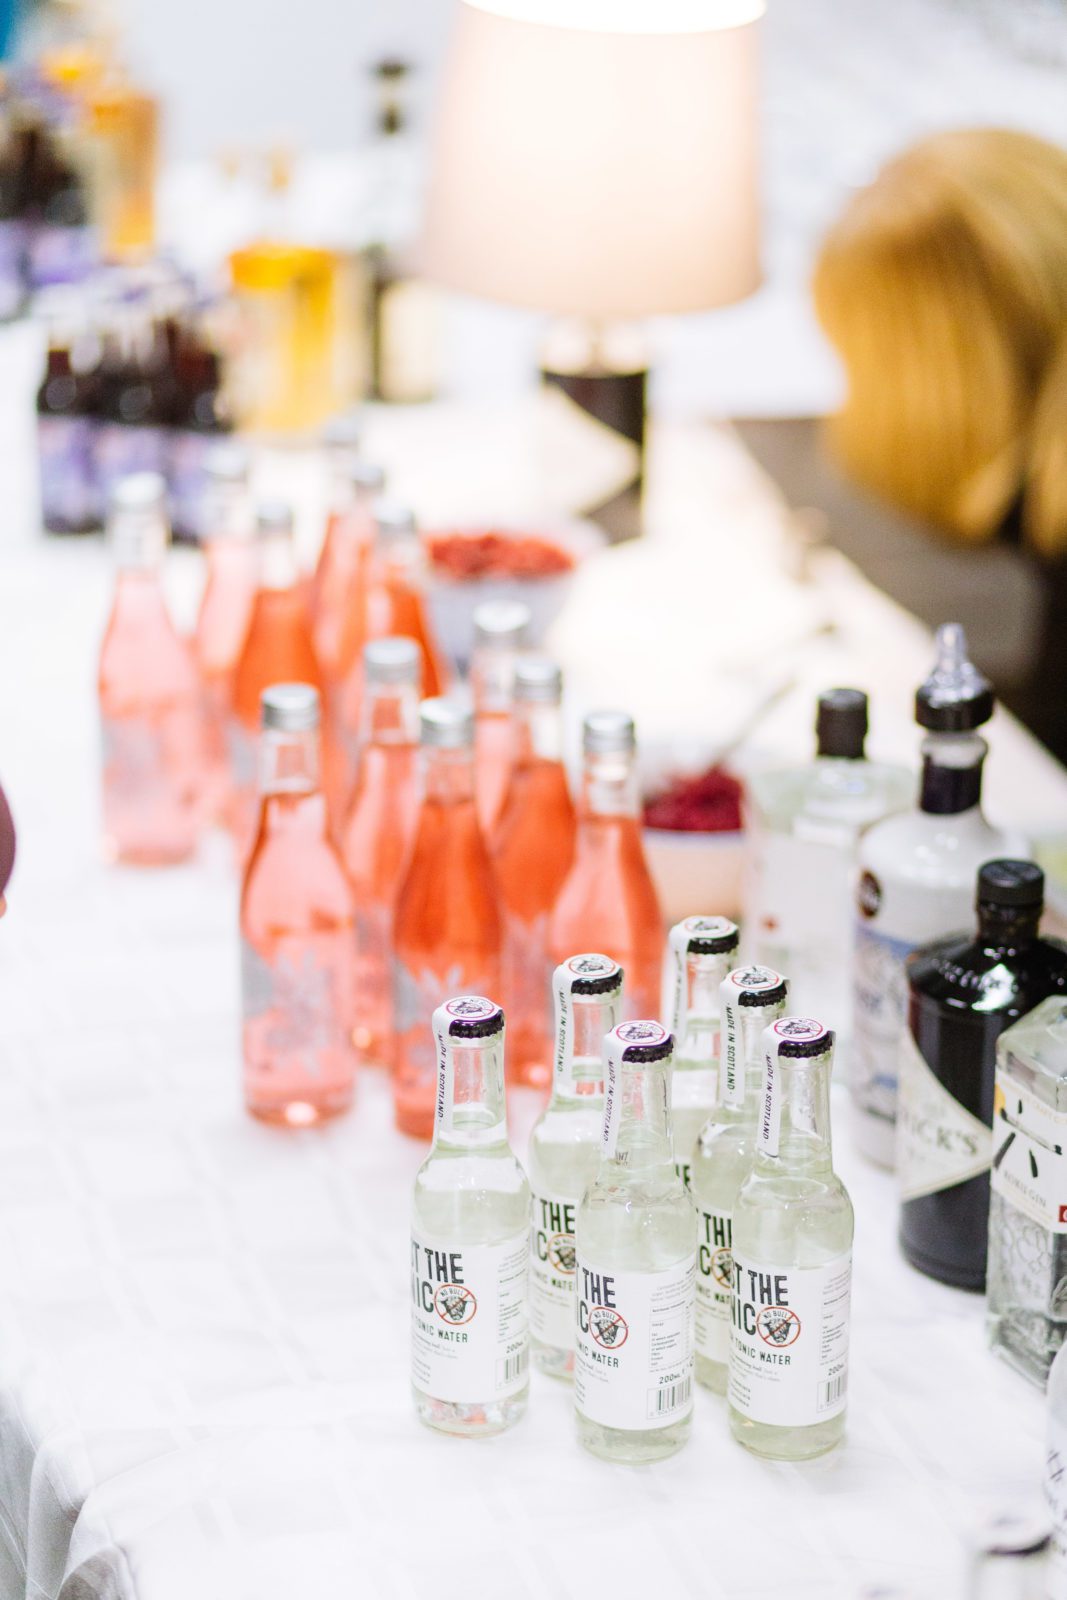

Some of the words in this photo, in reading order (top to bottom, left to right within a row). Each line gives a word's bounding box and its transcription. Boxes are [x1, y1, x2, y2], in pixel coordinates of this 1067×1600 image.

[560, 1016, 566, 1026] IN
[726, 1006, 735, 1029] MADE
[438, 1033, 446, 1058] MADE
[728, 1032, 736, 1042] IN
[440, 1060, 446, 1071] IN
[608, 1059, 616, 1083] MADE
[727, 1045, 736, 1090] SCOTLAND
[766, 1055, 774, 1079] MADE
[438, 1072, 446, 1118] SCOTLAND
[608, 1085, 614, 1096] IN
[766, 1082, 773, 1092] IN
[603, 1097, 613, 1142] SCOTLAND
[762, 1094, 773, 1140] SCOTLAND
[540, 1198, 575, 1234] THE
[424, 1247, 465, 1284] THE
[582, 1267, 616, 1308] THE
[748, 1269, 789, 1306] THE
[602, 1311, 616, 1321] BULL
[764, 1310, 772, 1319] NO
[772, 1310, 788, 1319] BULL
[438, 1329, 469, 1343] WATER
[592, 1354, 620, 1368] WATER
[760, 1354, 791, 1366] WATER
